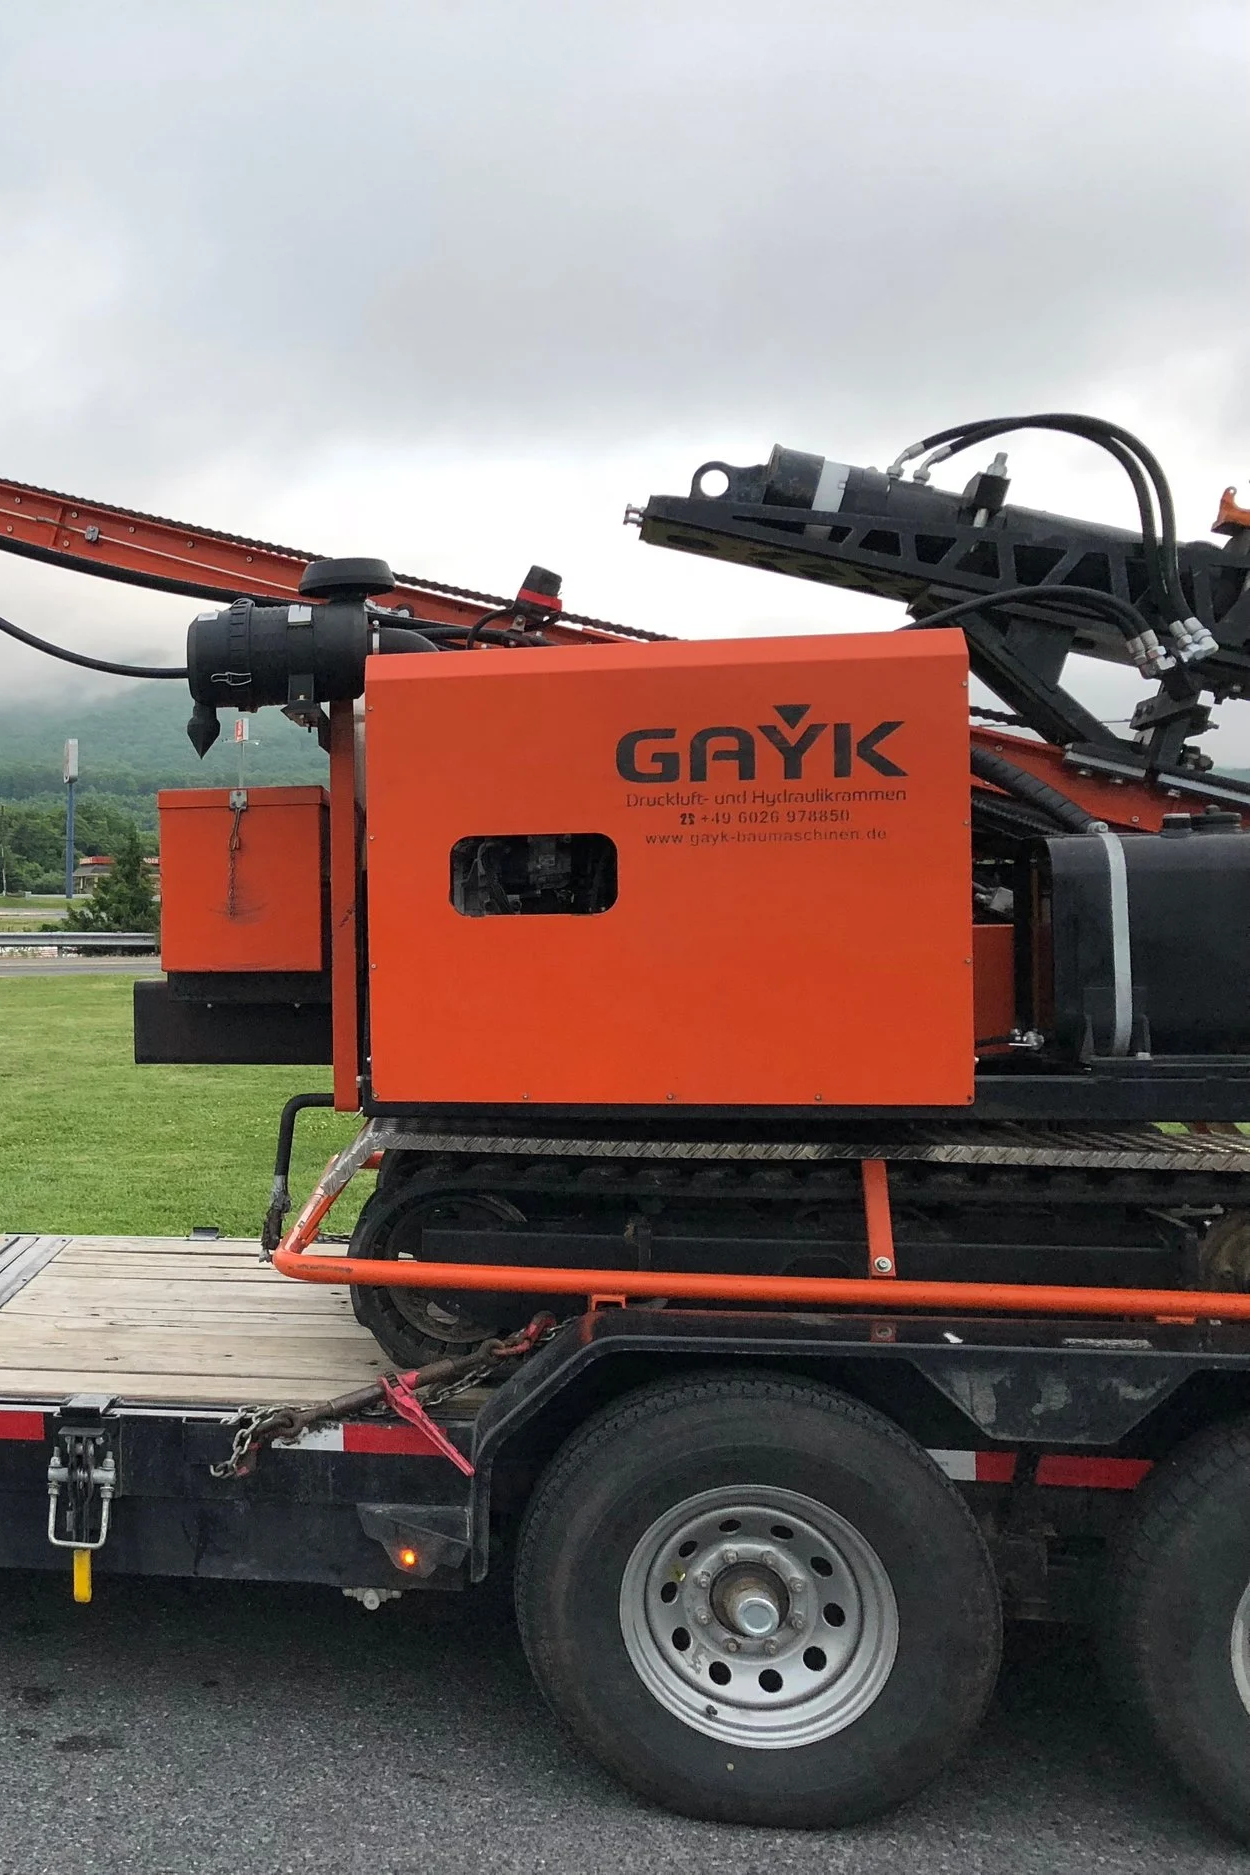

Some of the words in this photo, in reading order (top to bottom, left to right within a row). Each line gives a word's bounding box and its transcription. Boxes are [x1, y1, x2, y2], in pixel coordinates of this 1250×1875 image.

[616, 704, 909, 783] GAYK
[626, 791, 710, 807] Druckluft-
[714, 790, 747, 805] und
[752, 787, 907, 806] Hydraulikrammen
